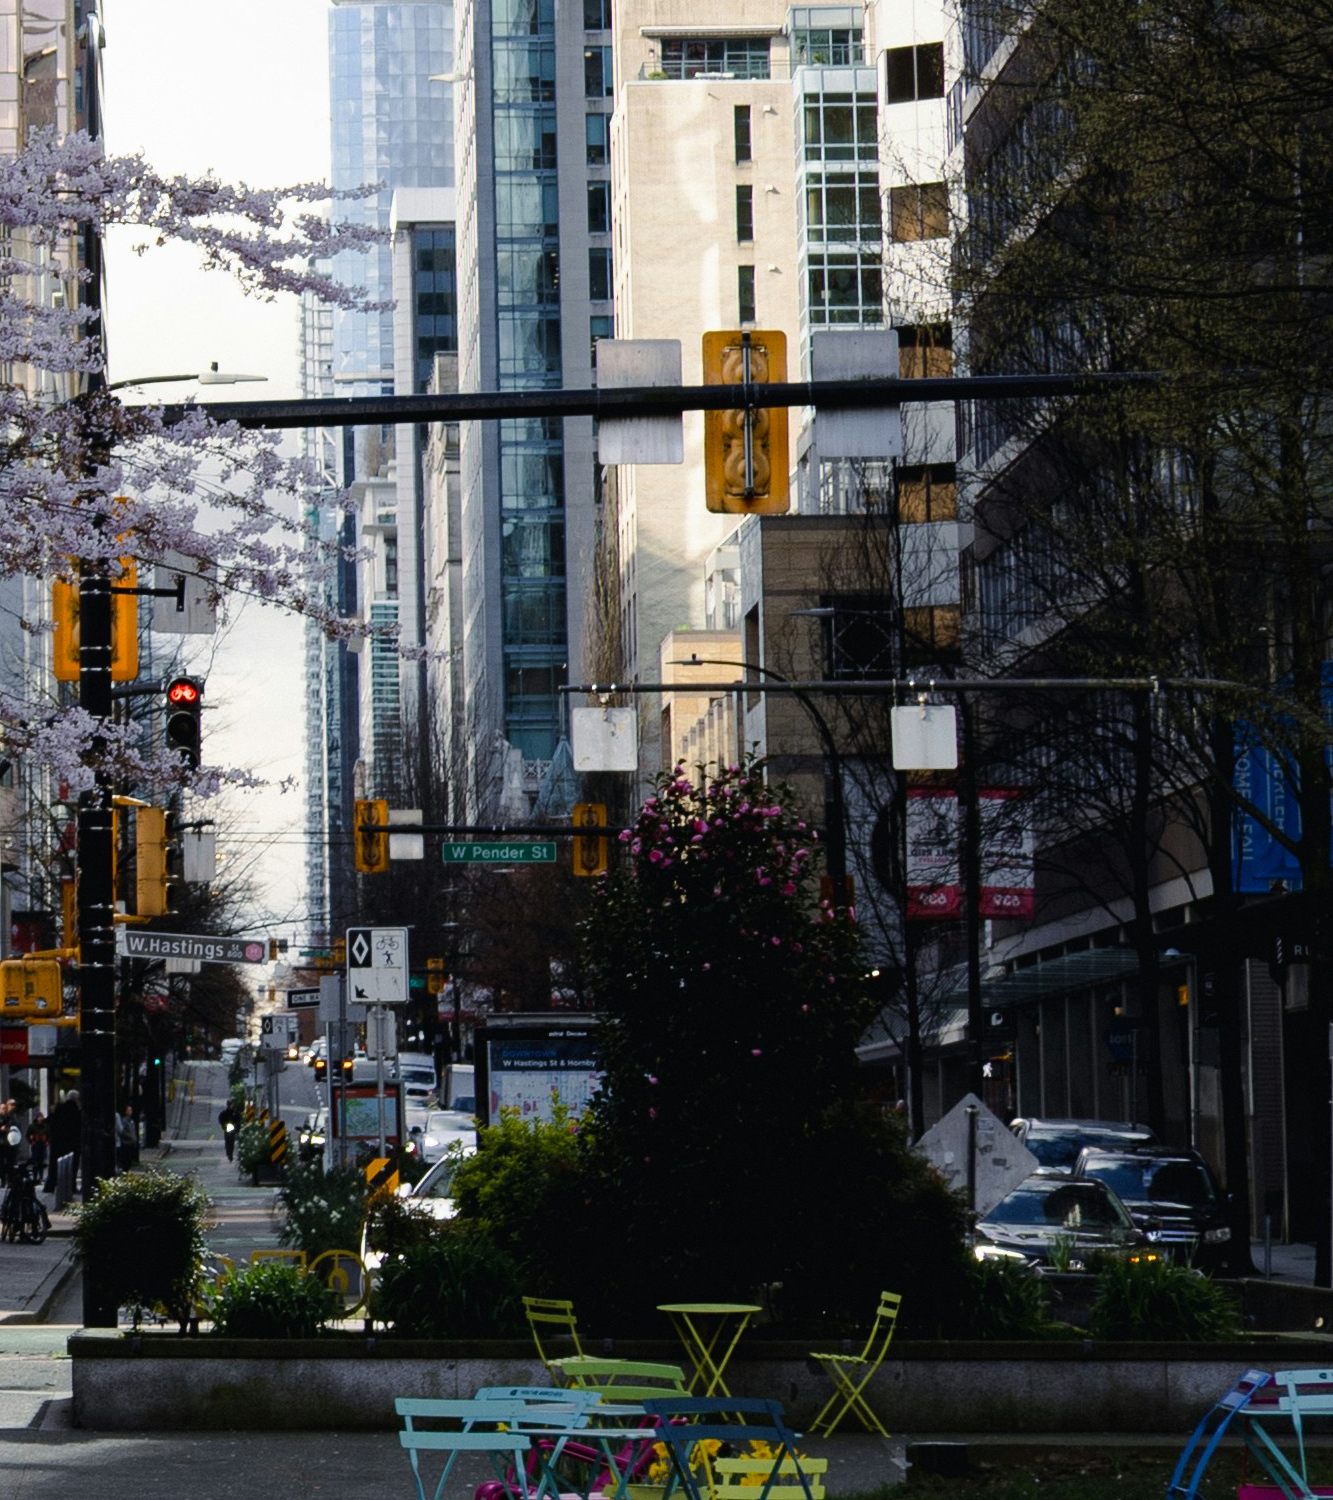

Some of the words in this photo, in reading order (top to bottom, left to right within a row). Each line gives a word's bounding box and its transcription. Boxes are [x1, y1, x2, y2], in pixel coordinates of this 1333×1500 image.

[451, 847, 465, 858] W
[472, 846, 524, 859] Pender
[531, 847, 549, 859] St
[513, 1060, 548, 1068] Hastings
[567, 1060, 597, 1068] Hornby
